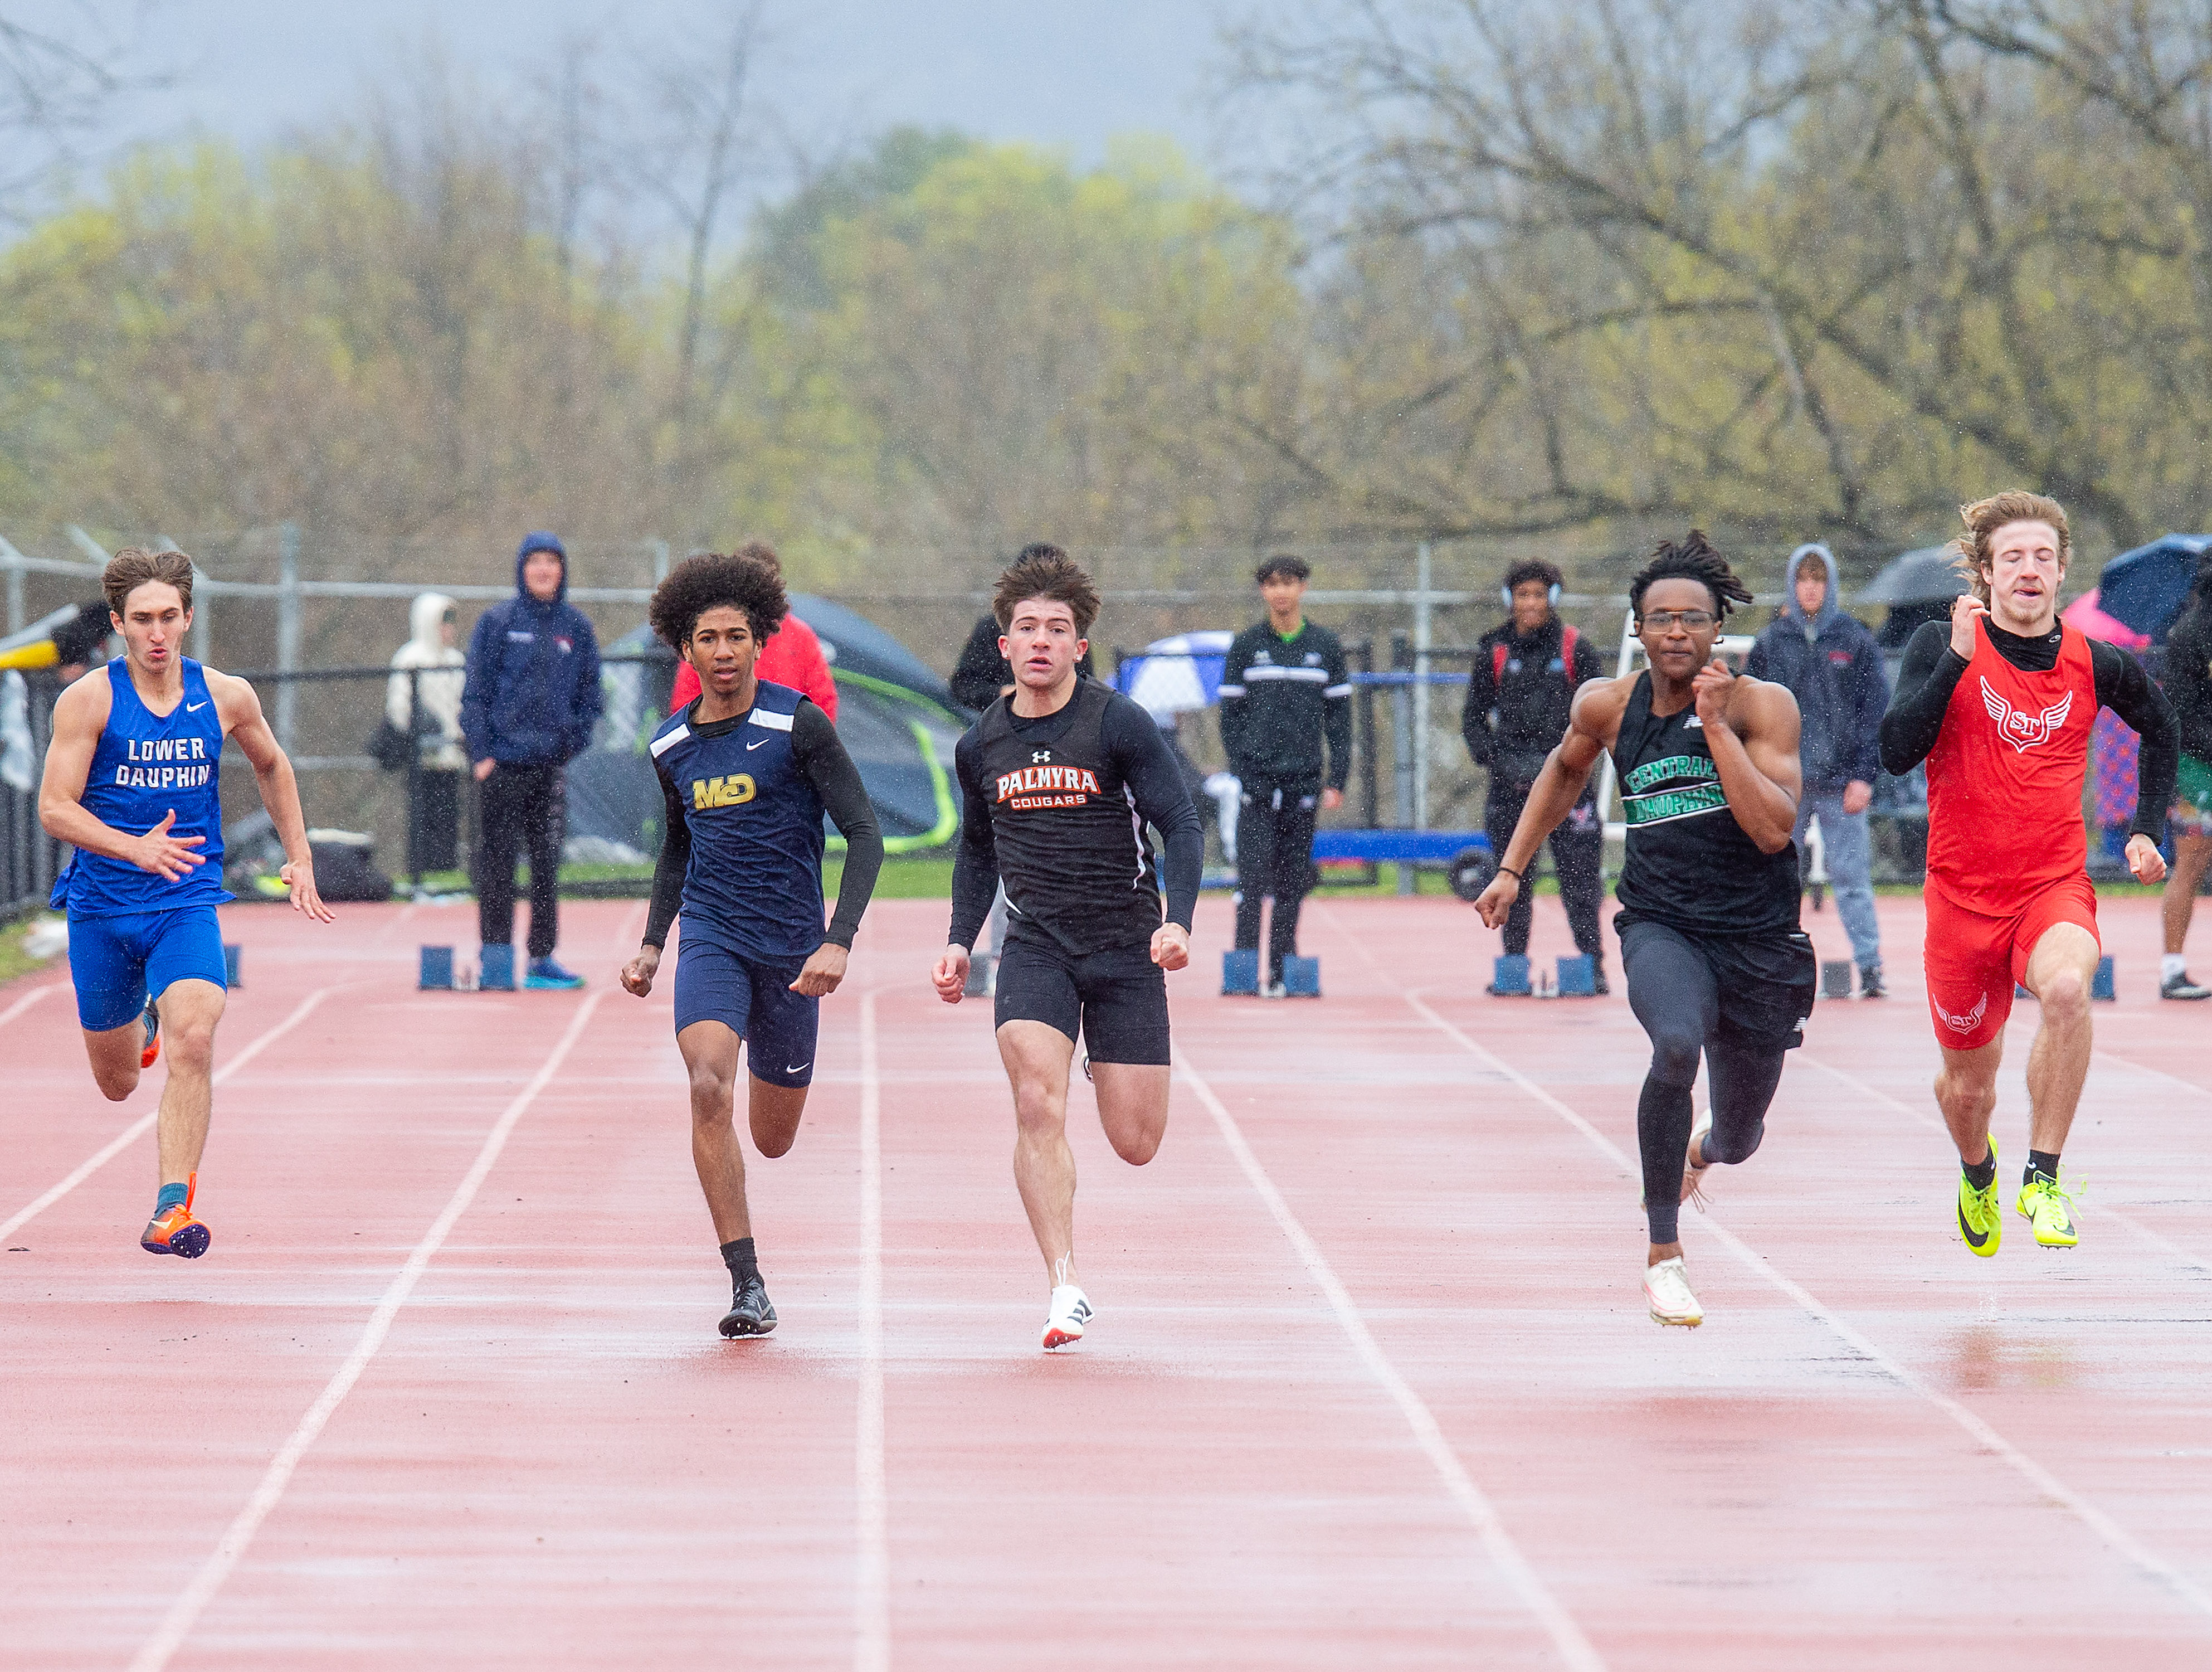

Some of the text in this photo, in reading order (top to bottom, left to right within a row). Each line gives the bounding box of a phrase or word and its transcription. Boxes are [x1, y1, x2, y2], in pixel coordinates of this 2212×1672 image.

[2009, 711, 2040, 736] ST
[128, 737, 206, 761] LOWER
[115, 764, 210, 789] DAUPHIN
[997, 766, 1102, 803] PALMYRA
[1624, 755, 1718, 794] CENTRAL
[1011, 794, 1087, 810] COUGARS
[1951, 1015, 1972, 1026] ST
